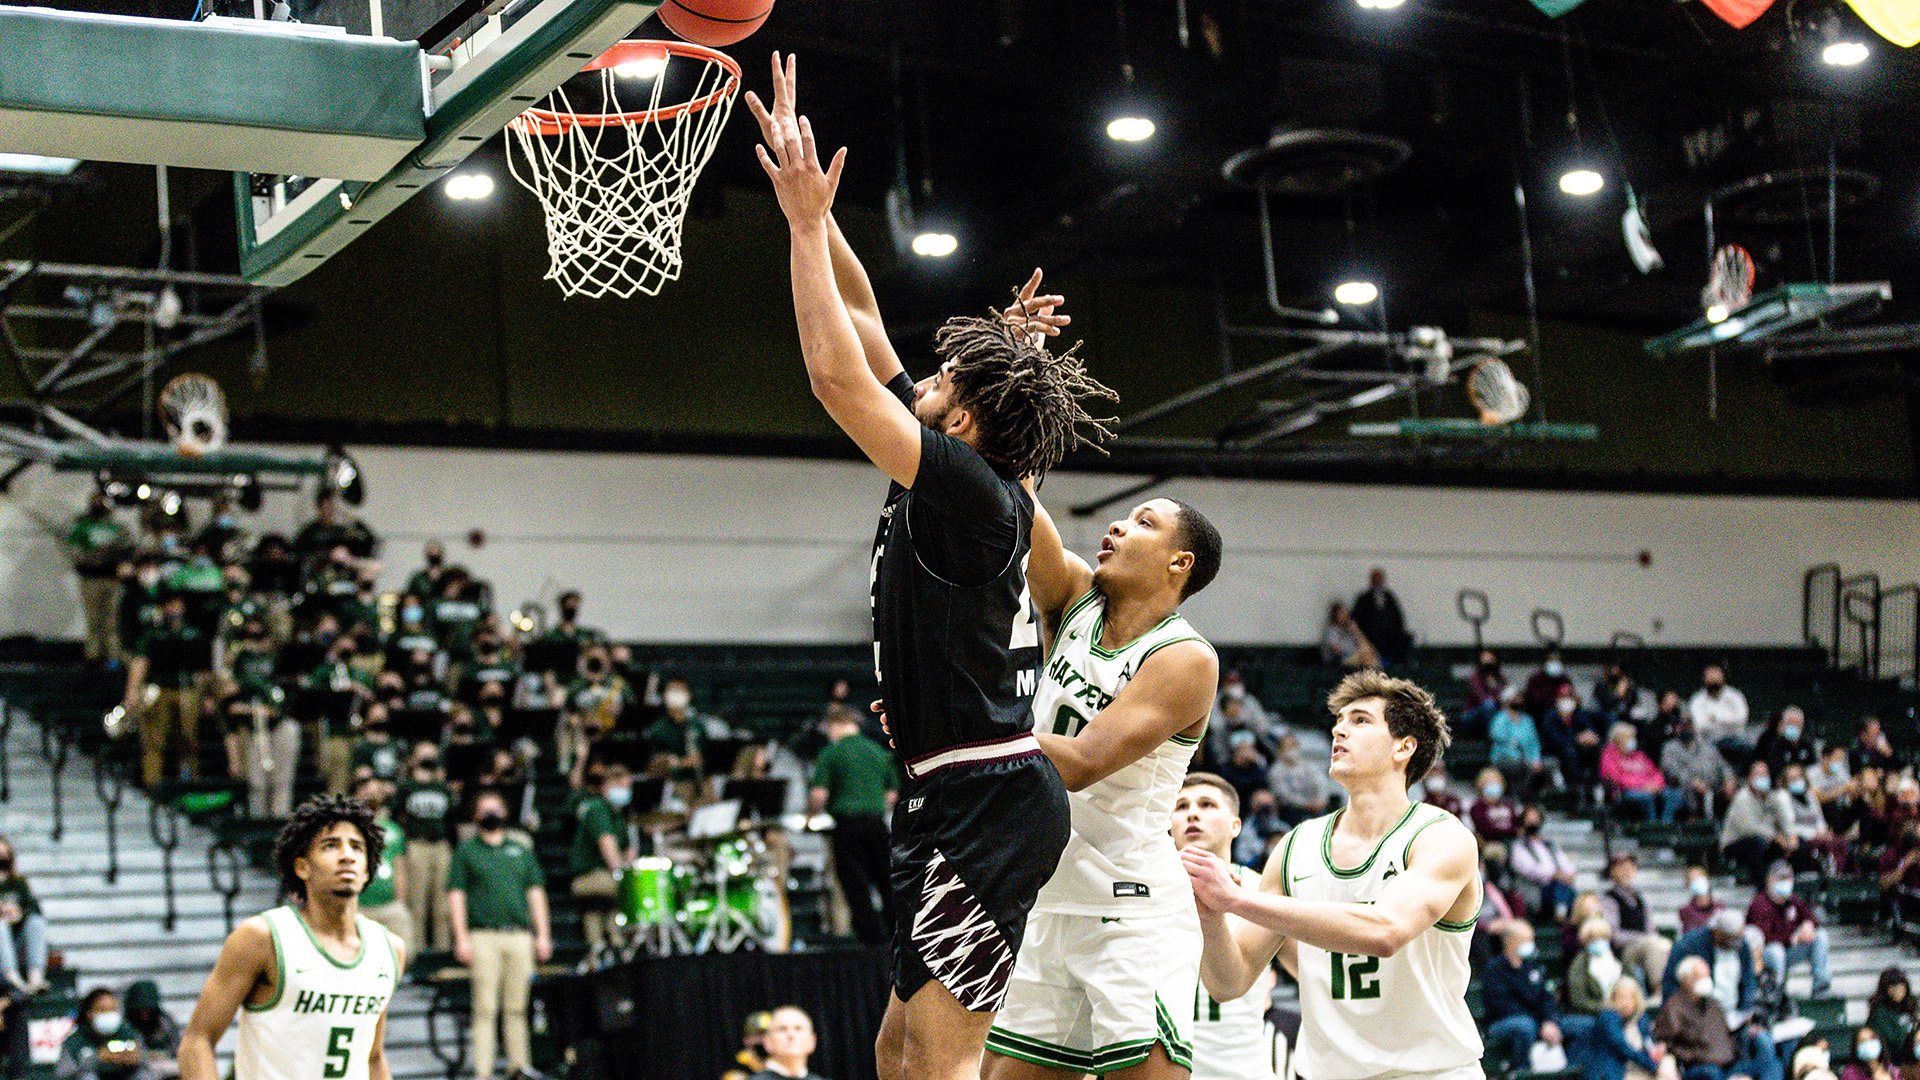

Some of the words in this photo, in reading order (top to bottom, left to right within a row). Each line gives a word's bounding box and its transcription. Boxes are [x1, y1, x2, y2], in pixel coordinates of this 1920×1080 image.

[1048, 654, 1116, 711] HATTER
[908, 797, 925, 809] EKU
[1325, 951, 1380, 1000] 12
[293, 990, 386, 1015] HATTERS
[323, 1026, 355, 1079] 5
